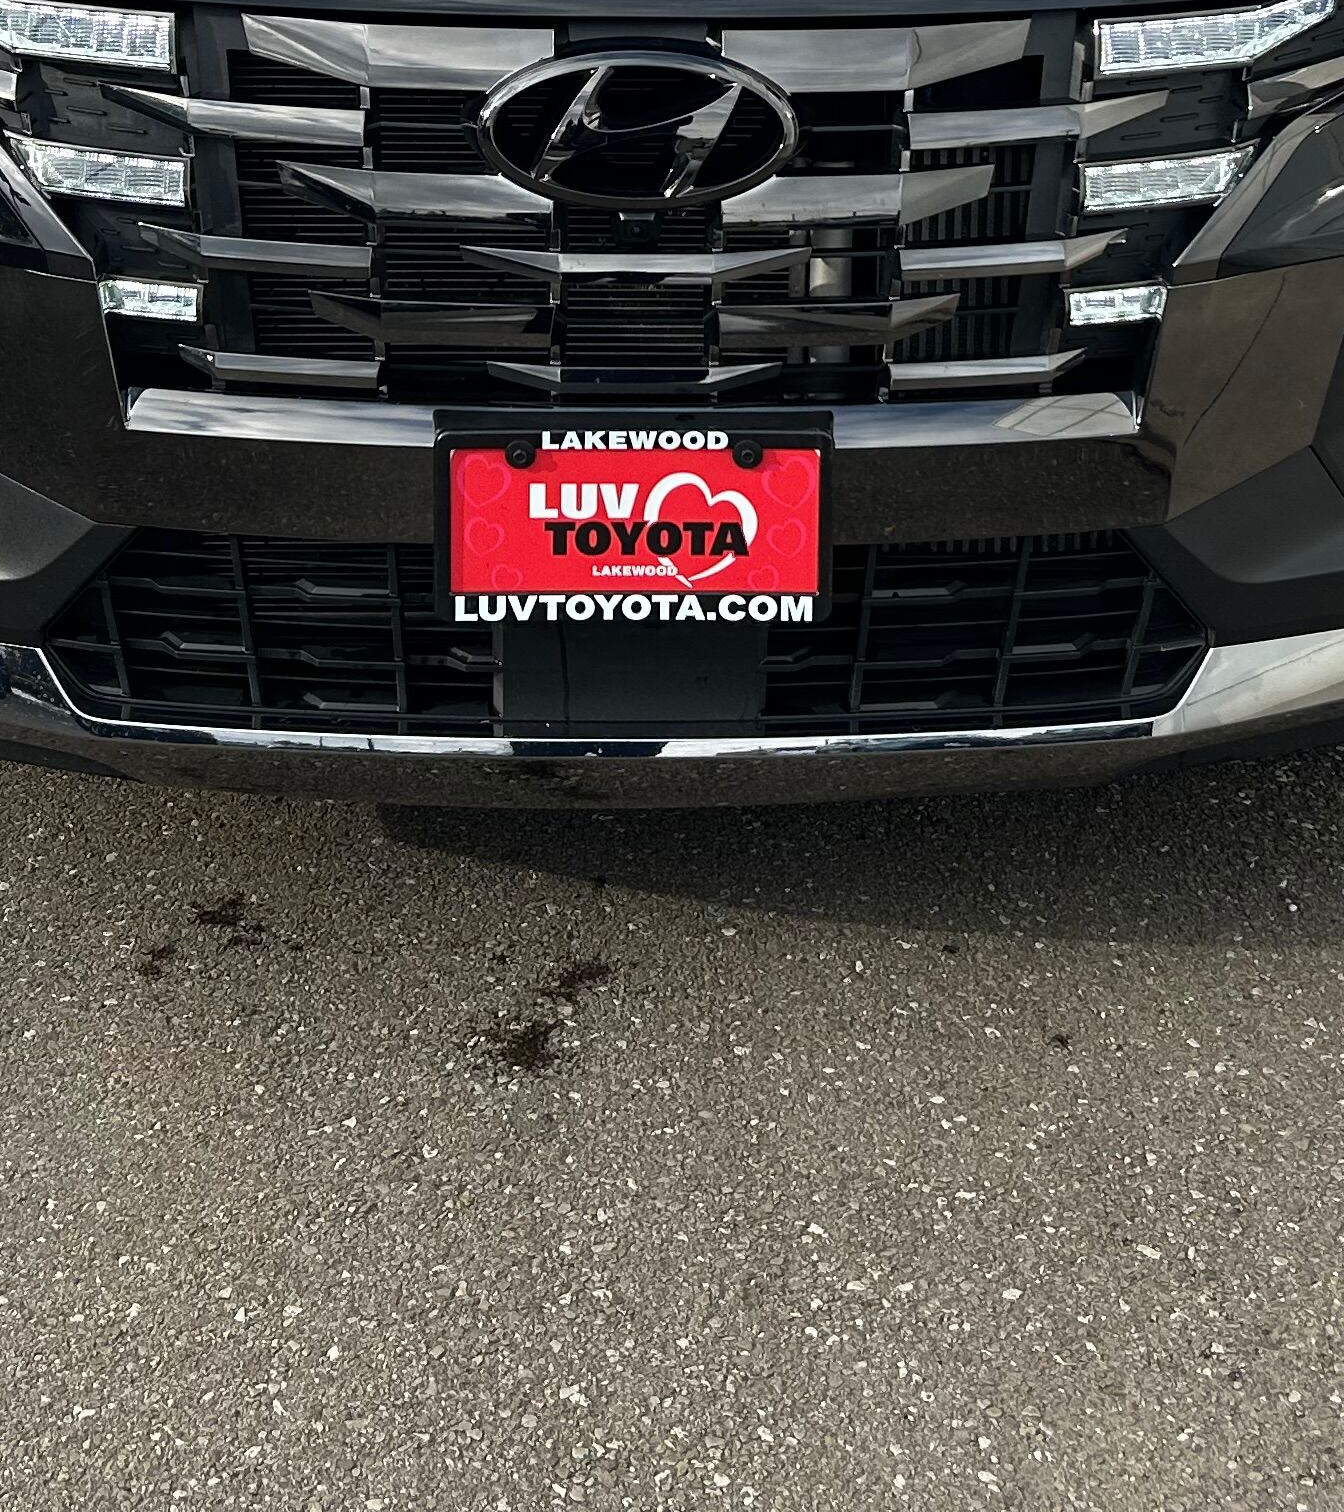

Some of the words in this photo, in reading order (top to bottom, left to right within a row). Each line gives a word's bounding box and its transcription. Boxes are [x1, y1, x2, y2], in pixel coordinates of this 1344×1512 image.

[541, 430, 729, 450] LAKEWOOD
[528, 483, 640, 519] LUV
[544, 521, 750, 556] TOYOTA
[591, 564, 678, 578] LAKEWOOD
[454, 594, 814, 622] LUVTOYOTA.COM
